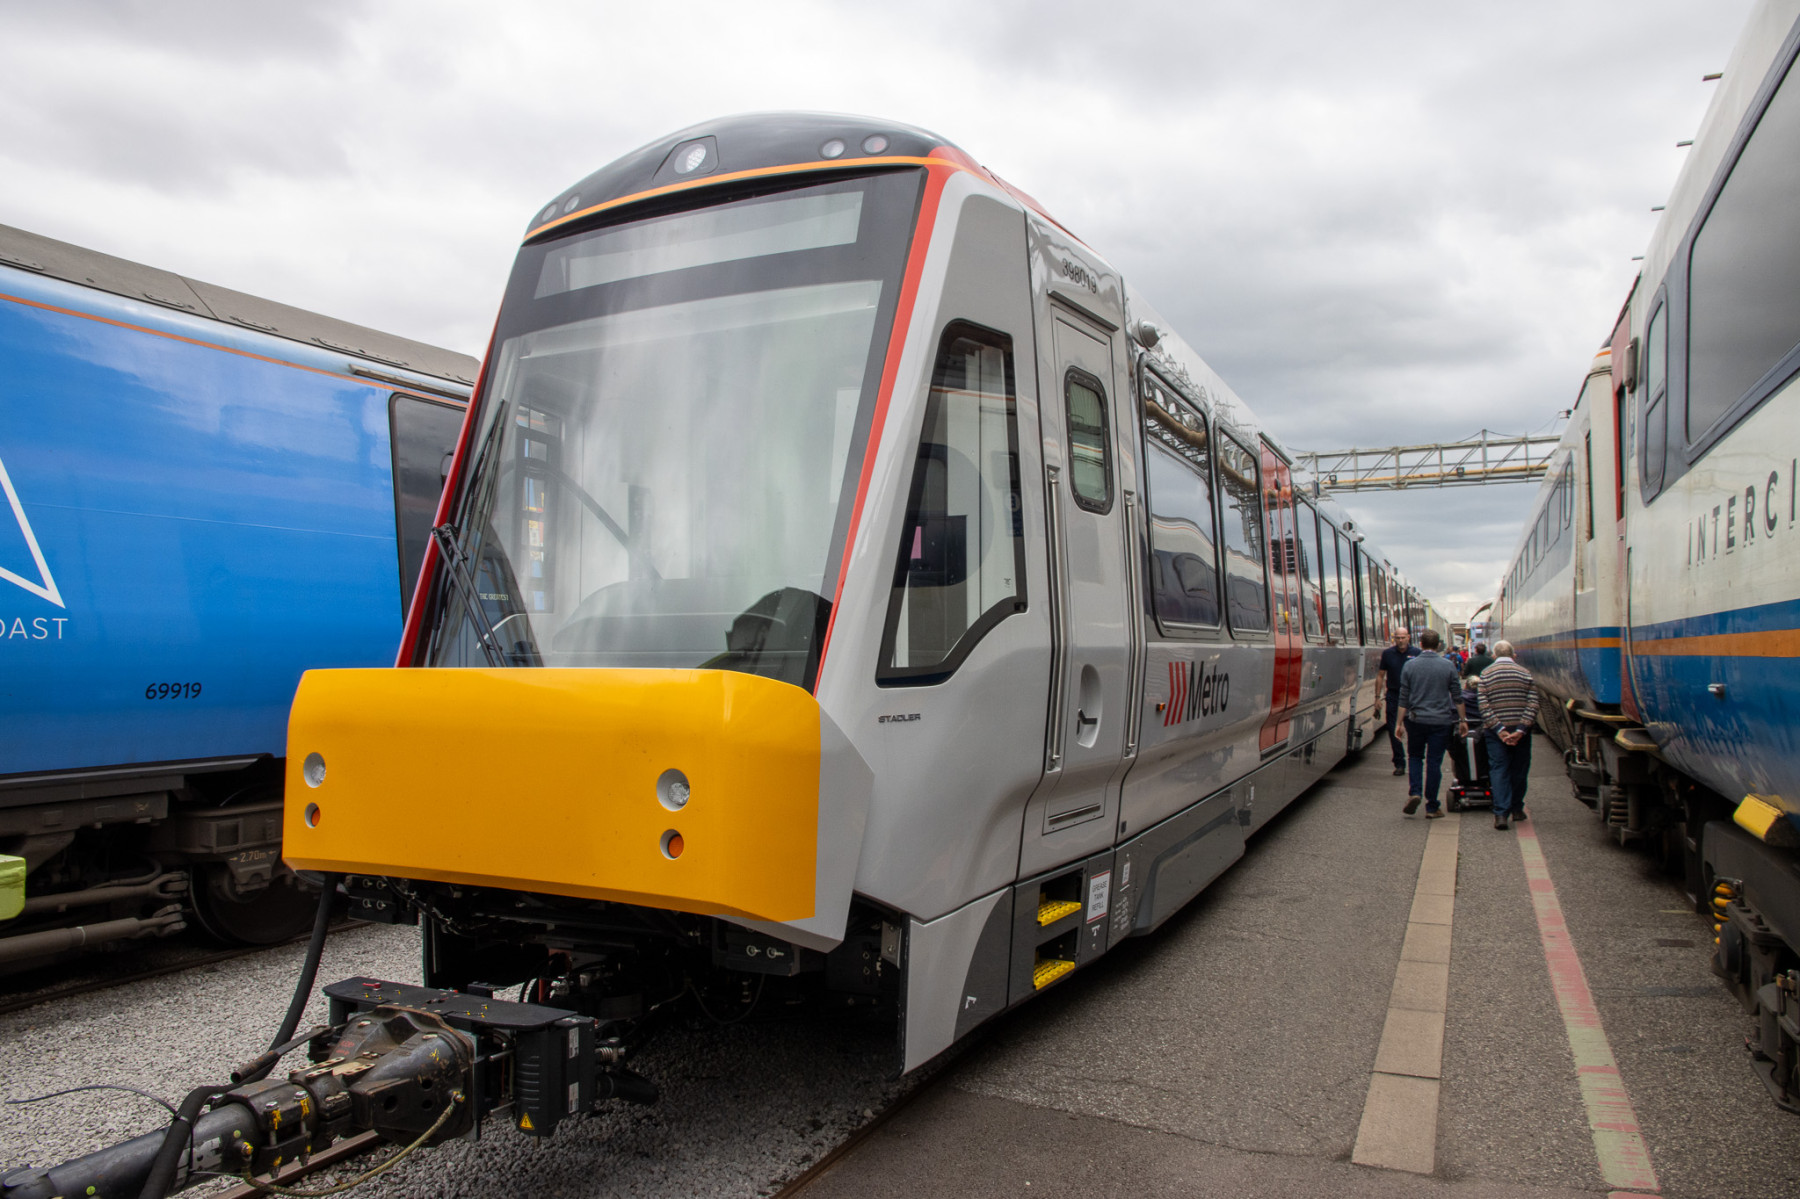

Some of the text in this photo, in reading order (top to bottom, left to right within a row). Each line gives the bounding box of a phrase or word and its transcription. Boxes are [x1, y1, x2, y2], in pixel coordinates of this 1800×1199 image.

[1062, 258, 1097, 294] 398019
[0, 617, 68, 639] AST
[145, 682, 202, 700] 69919
[1186, 661, 1230, 722] Metro
[878, 713, 921, 723] STADLER
[240, 850, 267, 863] 2.70m
